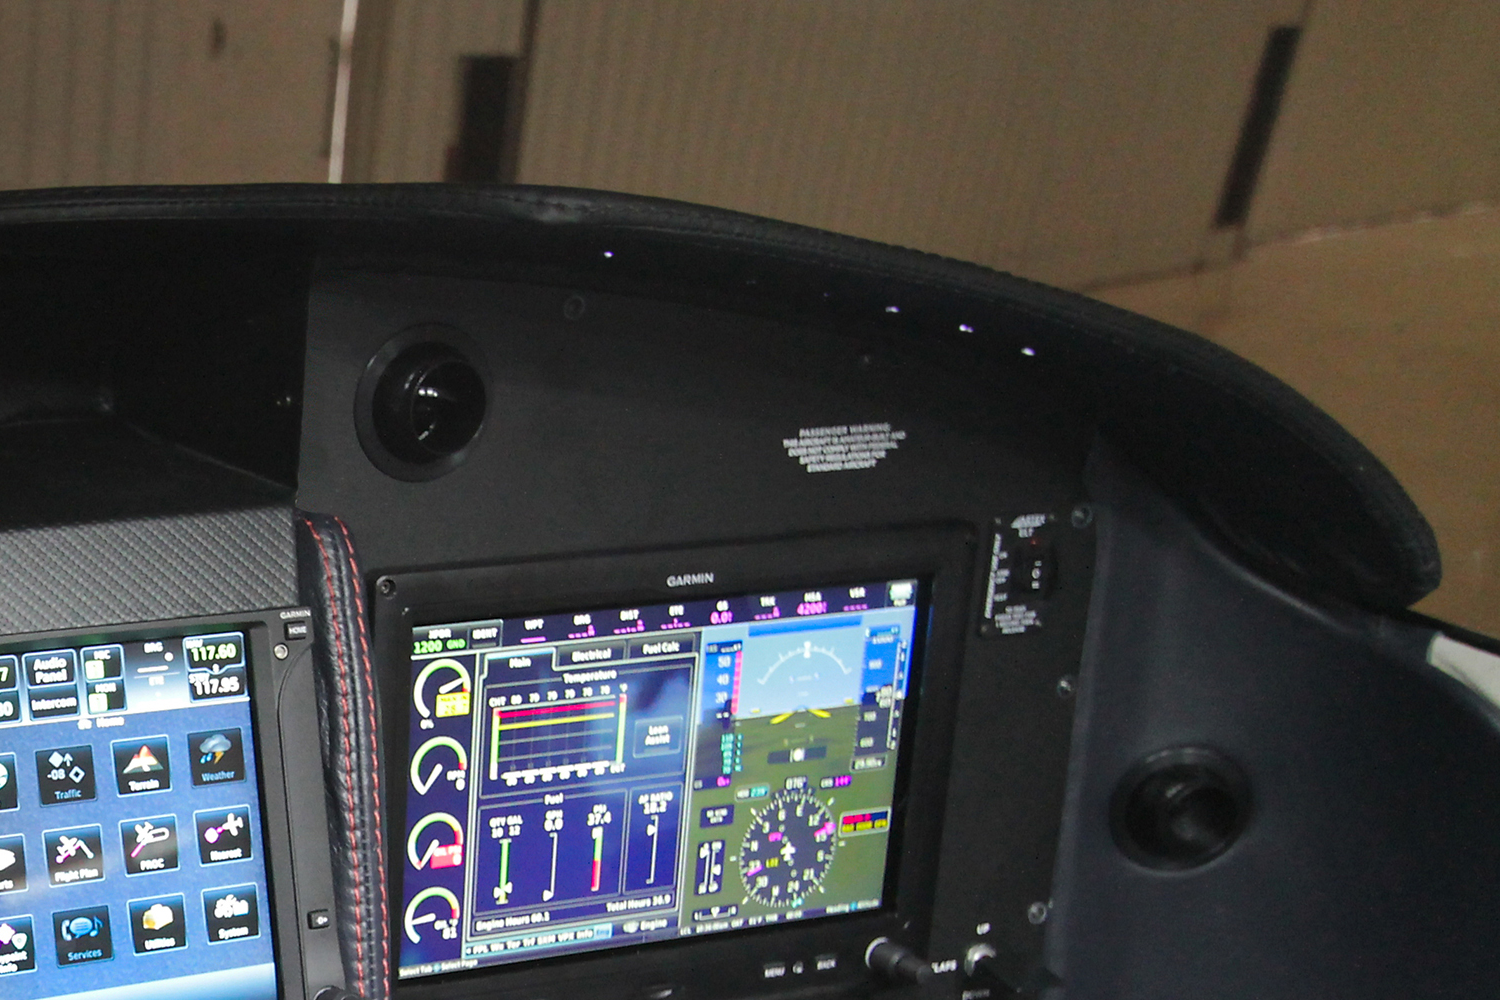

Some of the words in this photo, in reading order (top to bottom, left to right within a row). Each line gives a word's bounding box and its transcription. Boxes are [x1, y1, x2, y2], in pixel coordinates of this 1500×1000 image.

[667, 572, 714, 587] GARMIN
[280, 610, 310, 619] GARMIN
[289, 625, 306, 634] HOME
[413, 640, 442, 654] 1200
[447, 638, 465, 649] GND
[643, 643, 660, 655] Fuel
[661, 641, 680, 653] Calc
[572, 648, 611, 662] Electrical
[33, 657, 67, 671] Audio
[509, 657, 531, 668] Main
[35, 669, 68, 683] Panel
[563, 669, 617, 684] Temperature
[32, 697, 77, 711] Intercom
[201, 769, 235, 782] Weather
[128, 779, 159, 791] Terrain
[54, 789, 82, 800] Traffic
[210, 848, 242, 861] Nearest
[54, 870, 79, 883] Flight
[606, 900, 627, 912] Total
[476, 917, 504, 931] Engine
[506, 914, 529, 926] Hours
[640, 919, 667, 930] Engine
[218, 926, 249, 940] System
[145, 937, 175, 950] Utilities
[68, 948, 102, 961] Services
[0, 963, 18, 974] Info
